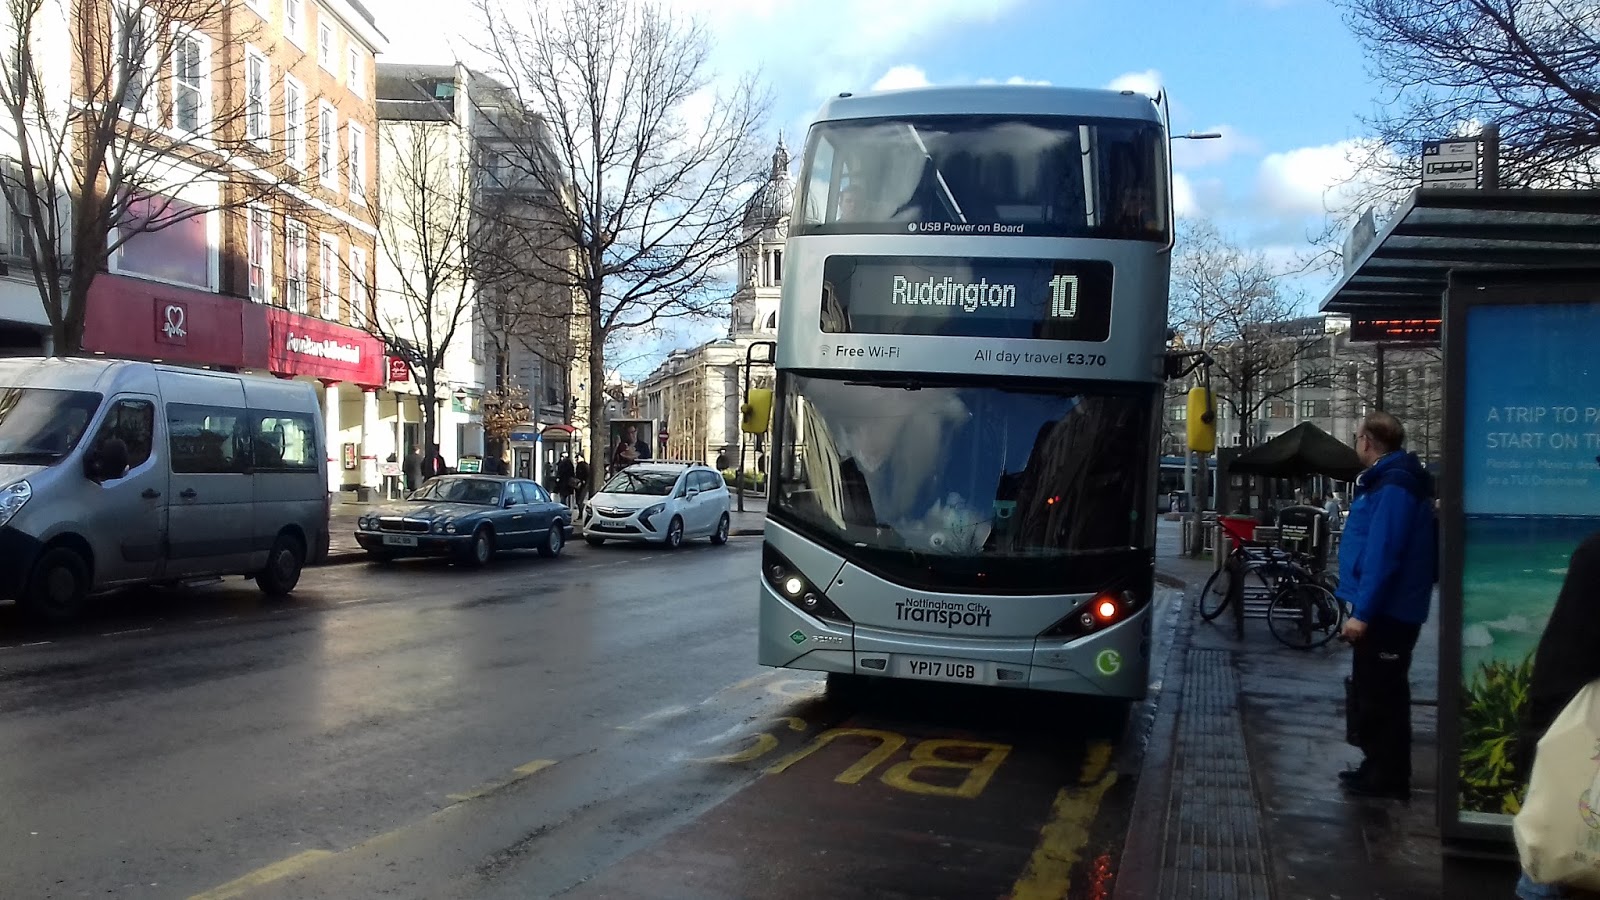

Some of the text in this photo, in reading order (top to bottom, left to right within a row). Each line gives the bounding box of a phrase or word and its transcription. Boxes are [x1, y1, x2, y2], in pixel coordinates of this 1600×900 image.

[919, 222, 1024, 233] USB Power on Board
[892, 274, 1079, 318] Ruddington 10
[835, 345, 900, 358] Free Wi-Fi
[974, 349, 1107, 367] All day travel £3.70
[1487, 406, 1500, 422] A
[1503, 406, 1547, 423] TRIP
[1552, 406, 1578, 423] TO
[1487, 432, 1544, 449] START
[1549, 432, 1578, 449] ON
[905, 598, 988, 614] Nottingham City
[895, 602, 992, 628] Transport
[909, 660, 975, 679] YP17 UGB
